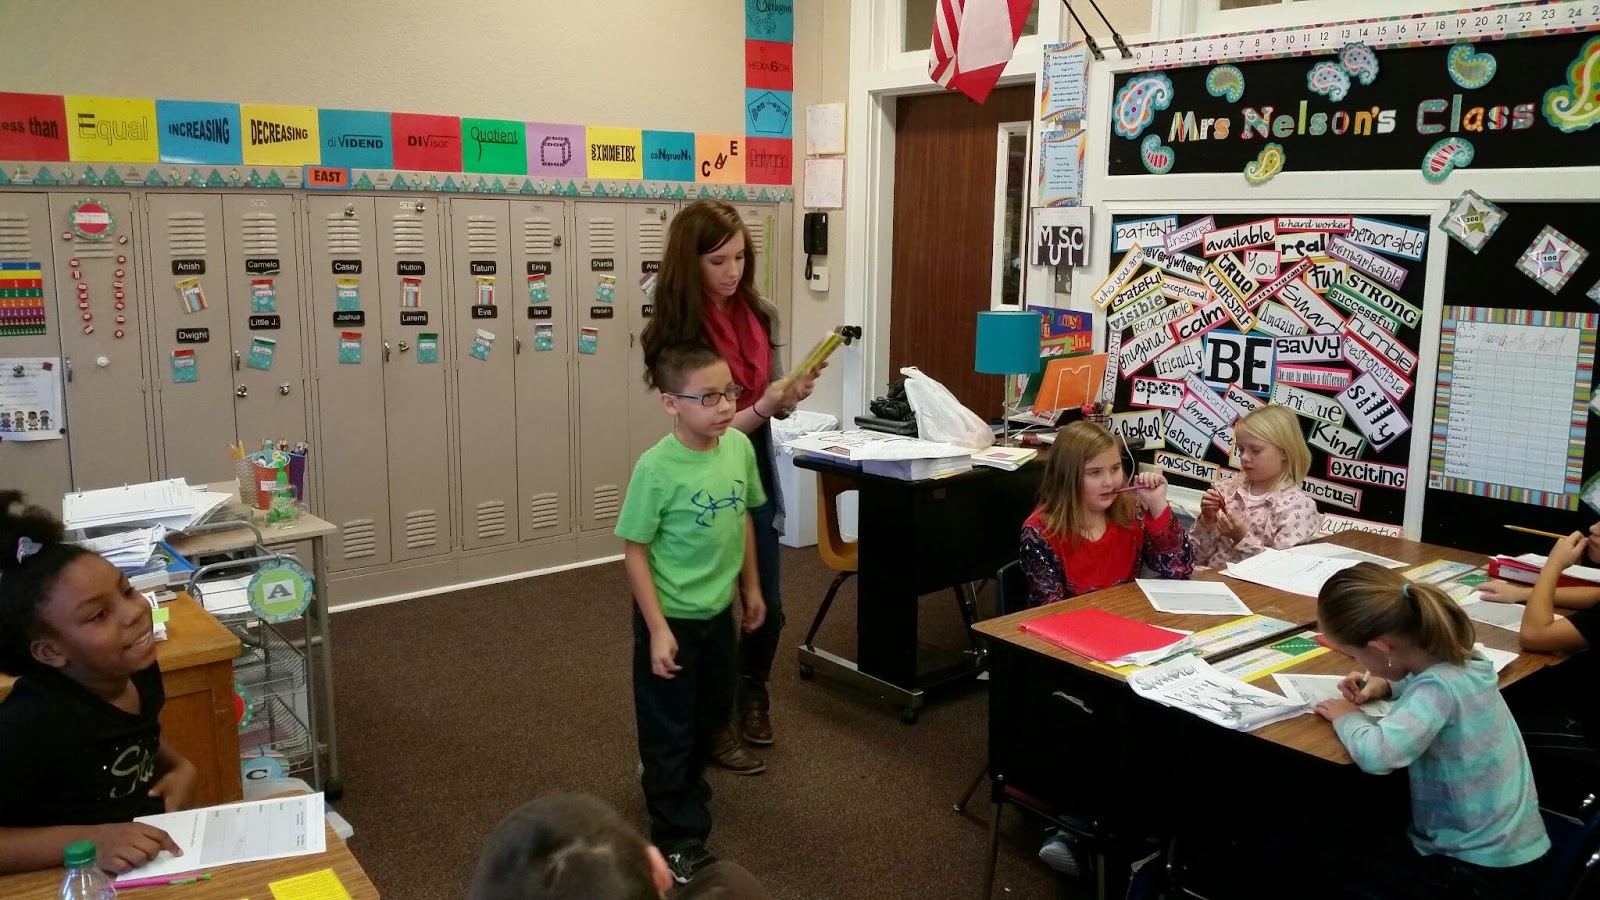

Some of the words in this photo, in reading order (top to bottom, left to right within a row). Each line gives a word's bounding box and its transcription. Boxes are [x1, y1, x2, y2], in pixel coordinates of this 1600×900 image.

[1136, 51, 1141, 59] 0
[1164, 49, 1169, 57] 2
[1178, 47, 1183, 55] 3
[1192, 45, 1198, 54] 4
[1208, 43, 1213, 52] 5
[1223, 42, 1229, 50] 6
[1239, 40, 1245, 49] 7
[1255, 38, 1260, 47] 8
[1271, 37, 1277, 45] 9
[1285, 35, 1295, 44] 10
[1303, 33, 1311, 42] 11
[1320, 31, 1329, 41] 12
[1341, 30, 1350, 39] 13
[1359, 28, 1368, 37] 14
[1377, 26, 1387, 35] 15
[1396, 24, 1406, 34] 16
[1416, 22, 1427, 31] 17
[1435, 20, 1446, 30] 18
[1456, 18, 1467, 28] 19
[1475, 16, 1489, 26] 20
[1496, 14, 1508, 24] 21
[1518, 12, 1532, 22] 22
[1541, 10, 1555, 20] 23
[1568, 8, 1582, 19] 24
[0, 121, 25, 133] ess
[28, 116, 58, 139] than
[77, 113, 149, 146] Equal
[168, 117, 230, 147] INCREASING
[250, 118, 308, 146] DECREASING
[1168, 111, 1231, 142] Mrs
[1241, 100, 1398, 140] Nelson's
[1416, 94, 1536, 136] Class
[470, 126, 518, 147] Quotient
[313, 169, 341, 183] EAST
[1169, 222, 1212, 248] Inspired
[1288, 219, 1313, 229] hard
[1315, 219, 1349, 229] worker
[1206, 225, 1275, 252] available
[1281, 233, 1326, 257] real
[1345, 226, 1422, 256] memorable
[177, 262, 200, 271] Anish
[335, 263, 360, 272] Casey
[400, 264, 422, 272] Hutton
[471, 264, 495, 272] Tatum
[1145, 248, 1204, 276] everywhere
[1330, 242, 1401, 285] remarkable
[1096, 284, 1115, 305] who
[1114, 267, 1131, 288] you
[1128, 251, 1143, 268] are
[1111, 294, 1163, 329] visible
[1203, 269, 1254, 326] YOURSELF
[1283, 284, 1344, 333] Smart
[1330, 290, 1398, 333] successful
[250, 319, 269, 327] Little
[336, 313, 361, 321] Joshua
[402, 314, 426, 322] Laremi
[1180, 306, 1226, 339] calm
[179, 331, 208, 341] Dwight
[1276, 337, 1340, 358] savvy
[1348, 313, 1413, 372] humble
[1104, 332, 1121, 401] CONFIDENT
[1155, 345, 1203, 374] friendly
[1204, 337, 1273, 393] BE
[1134, 380, 1184, 405] open
[1187, 372, 1235, 420] trustworthy
[1347, 385, 1396, 445] silly
[1163, 412, 1203, 459] Honest
[1311, 420, 1364, 460] Kind
[1157, 454, 1217, 480] CONSISTENT
[267, 583, 292, 599] A
[245, 769, 268, 780] C
